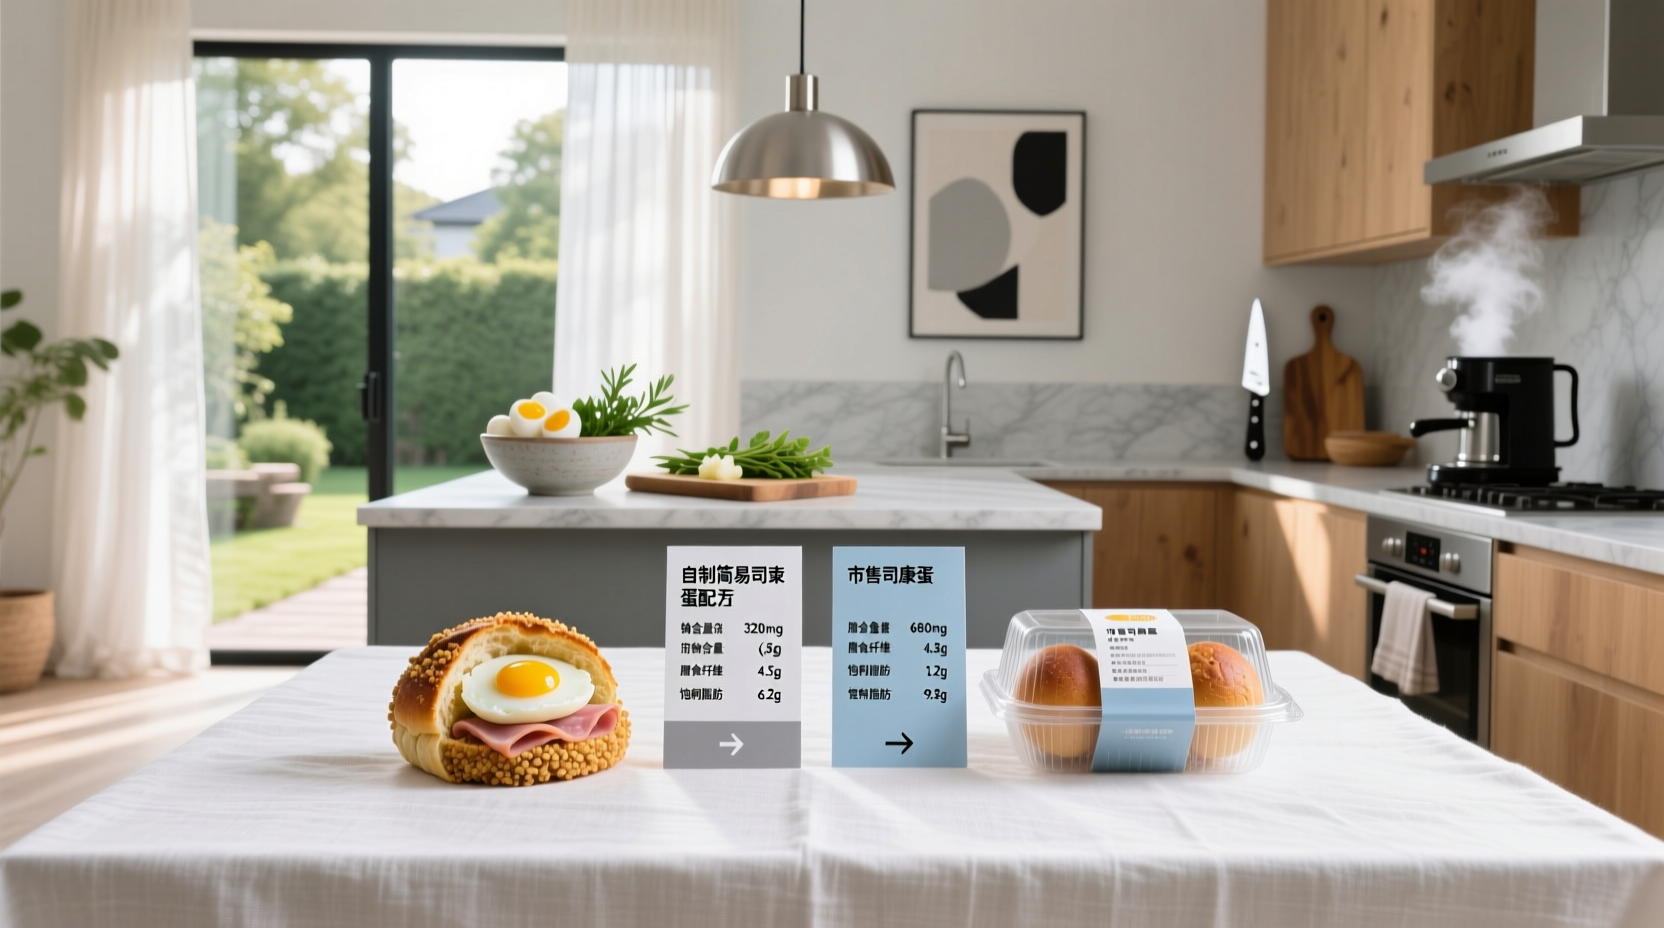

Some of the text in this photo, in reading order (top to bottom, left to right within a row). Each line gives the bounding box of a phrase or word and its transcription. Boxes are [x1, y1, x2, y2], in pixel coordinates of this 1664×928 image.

[848, 565, 934, 584] 市售司康蛋
[744, 622, 783, 637] 320mg
[924, 642, 947, 657] 4.3g
